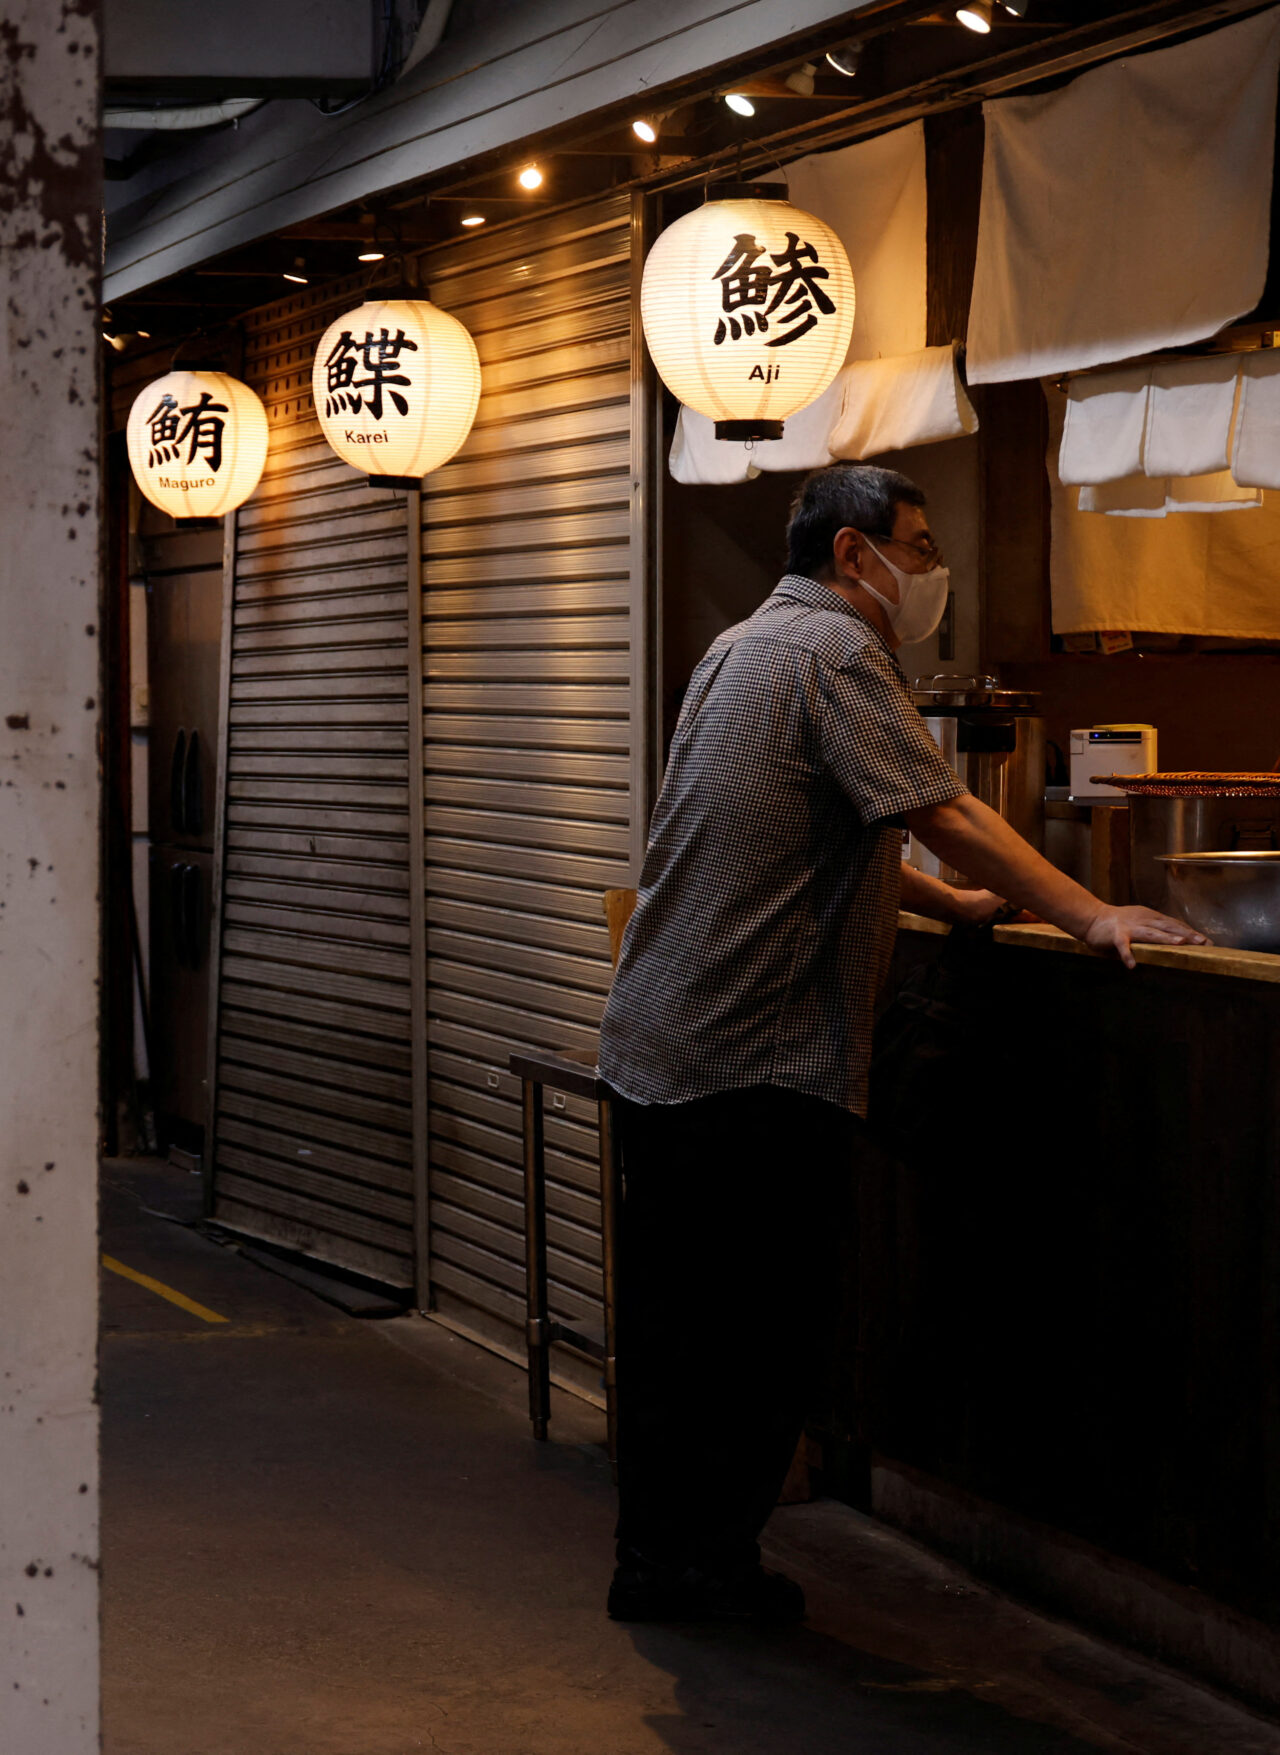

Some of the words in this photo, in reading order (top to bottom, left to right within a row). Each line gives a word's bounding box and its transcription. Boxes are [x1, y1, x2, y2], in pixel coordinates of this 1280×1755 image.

[324, 328, 418, 420] 鰈
[748, 365, 780, 385] Aji
[145, 392, 229, 473] 鮪
[345, 430, 389, 444] Karei
[159, 477, 215, 492] Maguro
